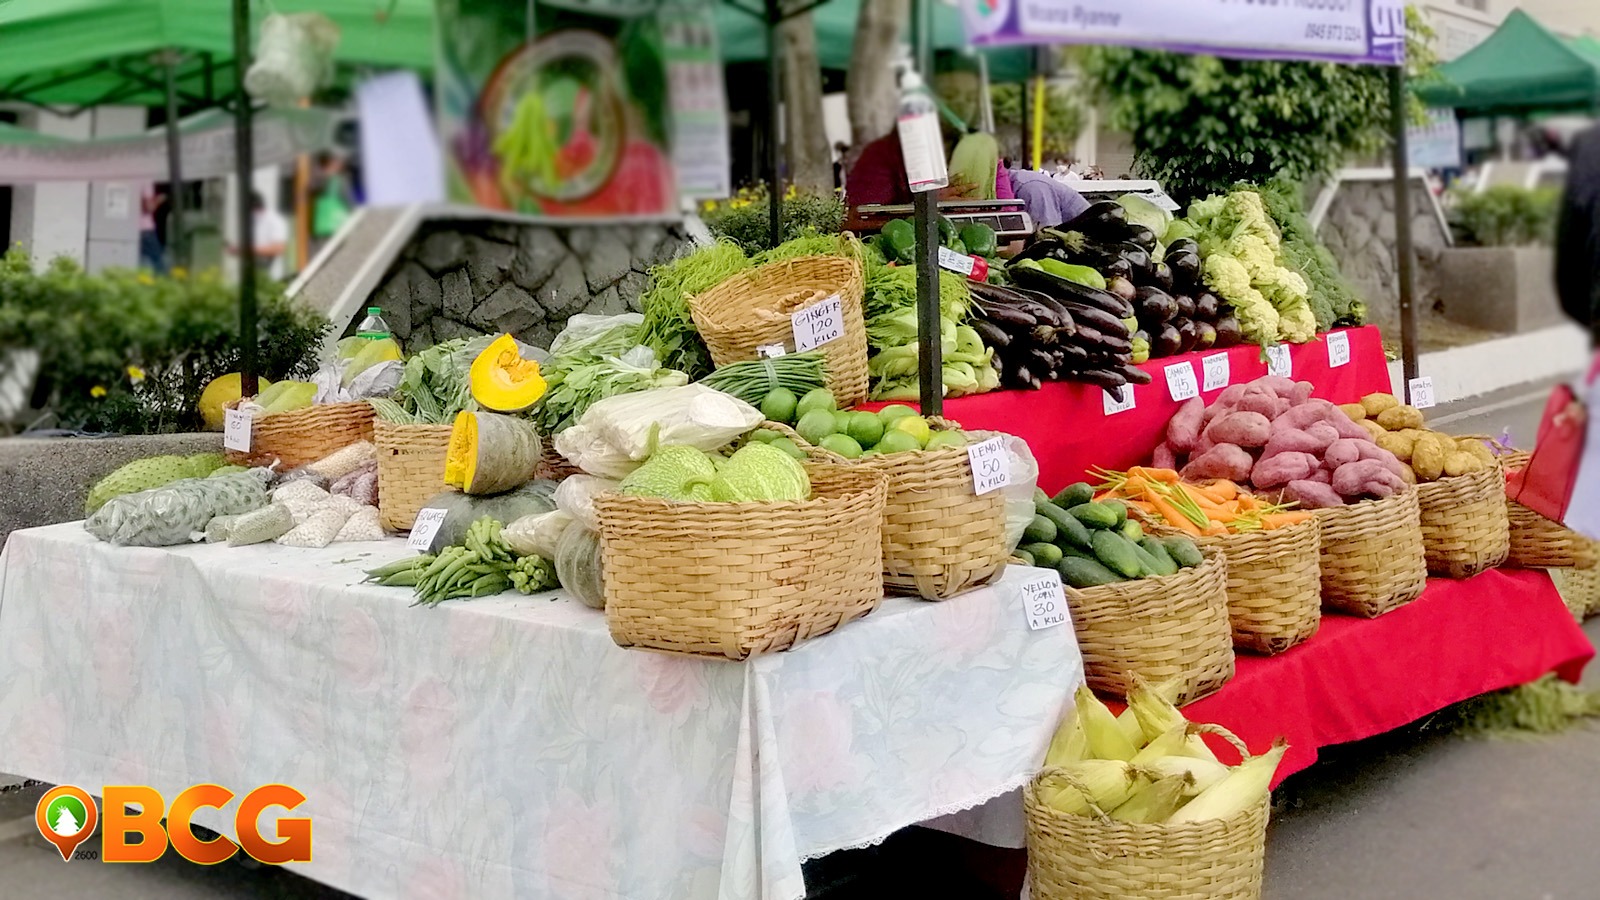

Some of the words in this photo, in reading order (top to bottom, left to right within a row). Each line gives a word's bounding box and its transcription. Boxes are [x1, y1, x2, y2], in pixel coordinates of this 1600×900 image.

[794, 301, 840, 327] GINGER
[811, 317, 833, 335] 120
[800, 342, 807, 350] A
[814, 329, 838, 346] KILO
[1334, 343, 1346, 356] 120
[1210, 365, 1223, 378] 60
[1174, 378, 1190, 391] 45
[1416, 390, 1427, 402] 20
[979, 457, 1001, 478] 50
[979, 480, 986, 490] A
[988, 473, 1006, 488] KILO
[1032, 601, 1055, 617] 30
[1032, 619, 1039, 628] A
[1043, 612, 1065, 626] KILO
